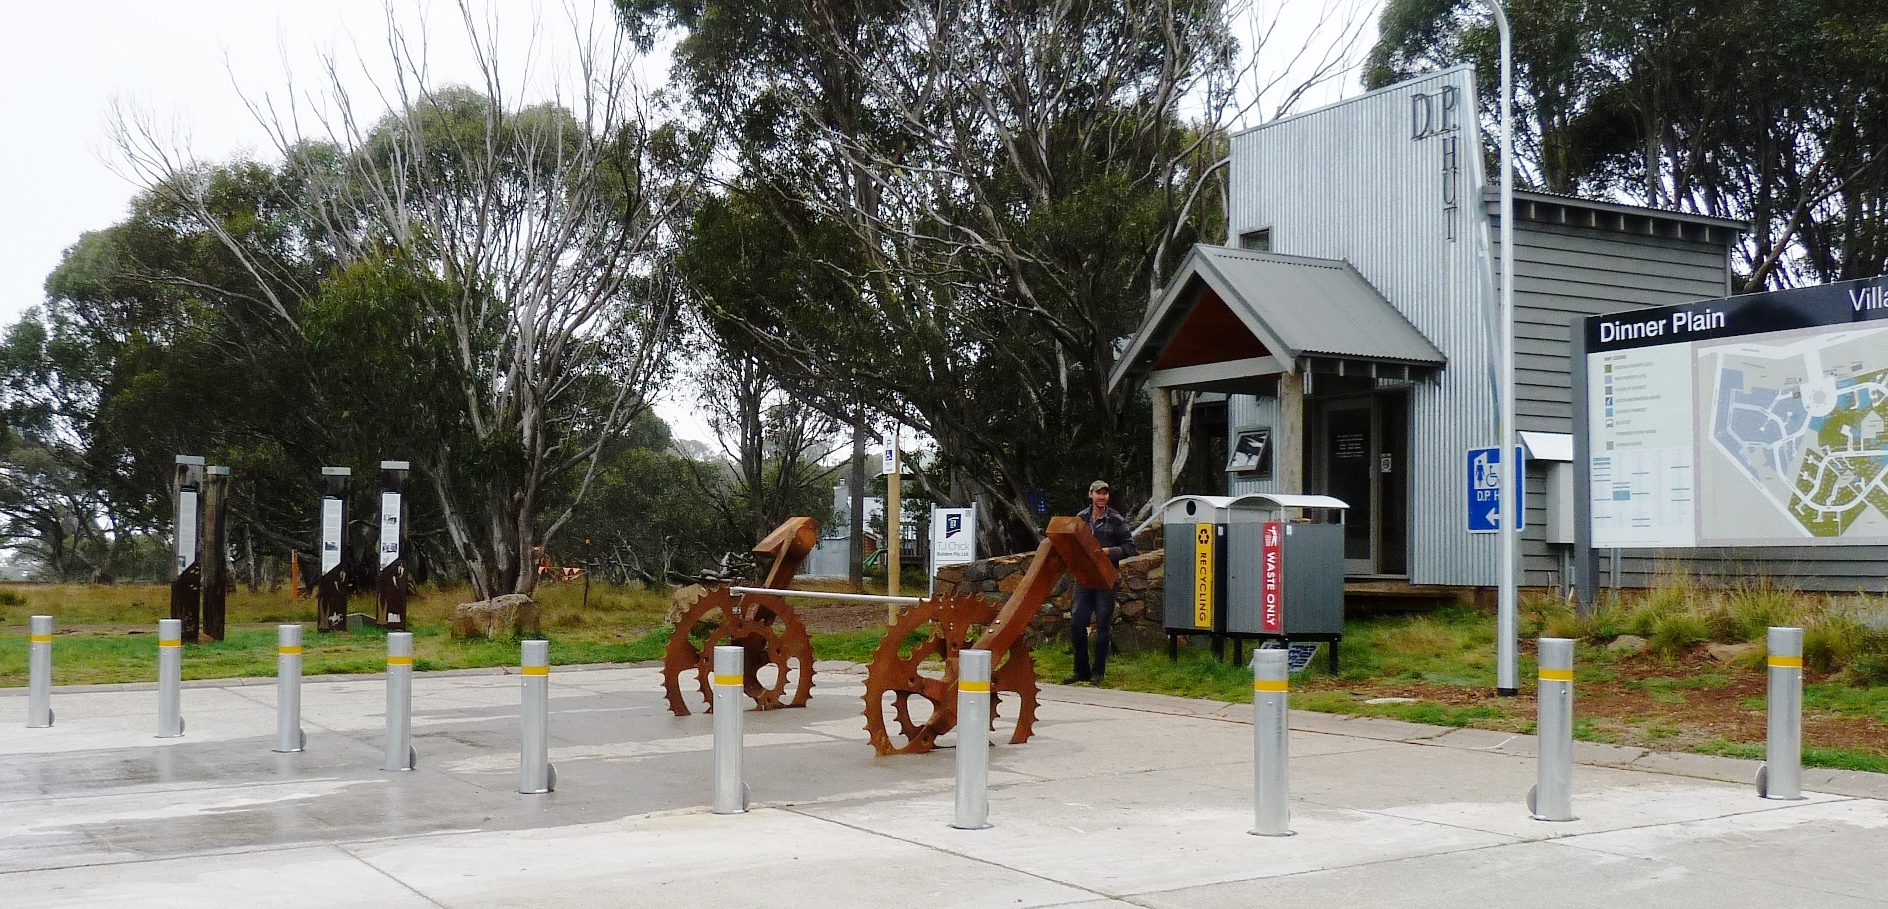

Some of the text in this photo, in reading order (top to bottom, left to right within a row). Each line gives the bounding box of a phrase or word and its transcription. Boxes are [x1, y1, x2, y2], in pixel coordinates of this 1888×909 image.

[1442, 135, 1457, 241] HUT
[1600, 308, 1725, 343] Dinner Plain
[948, 541, 970, 551] Chick
[1199, 552, 1207, 622] RECYCLING
[1266, 551, 1276, 626] WASTE ONLY
